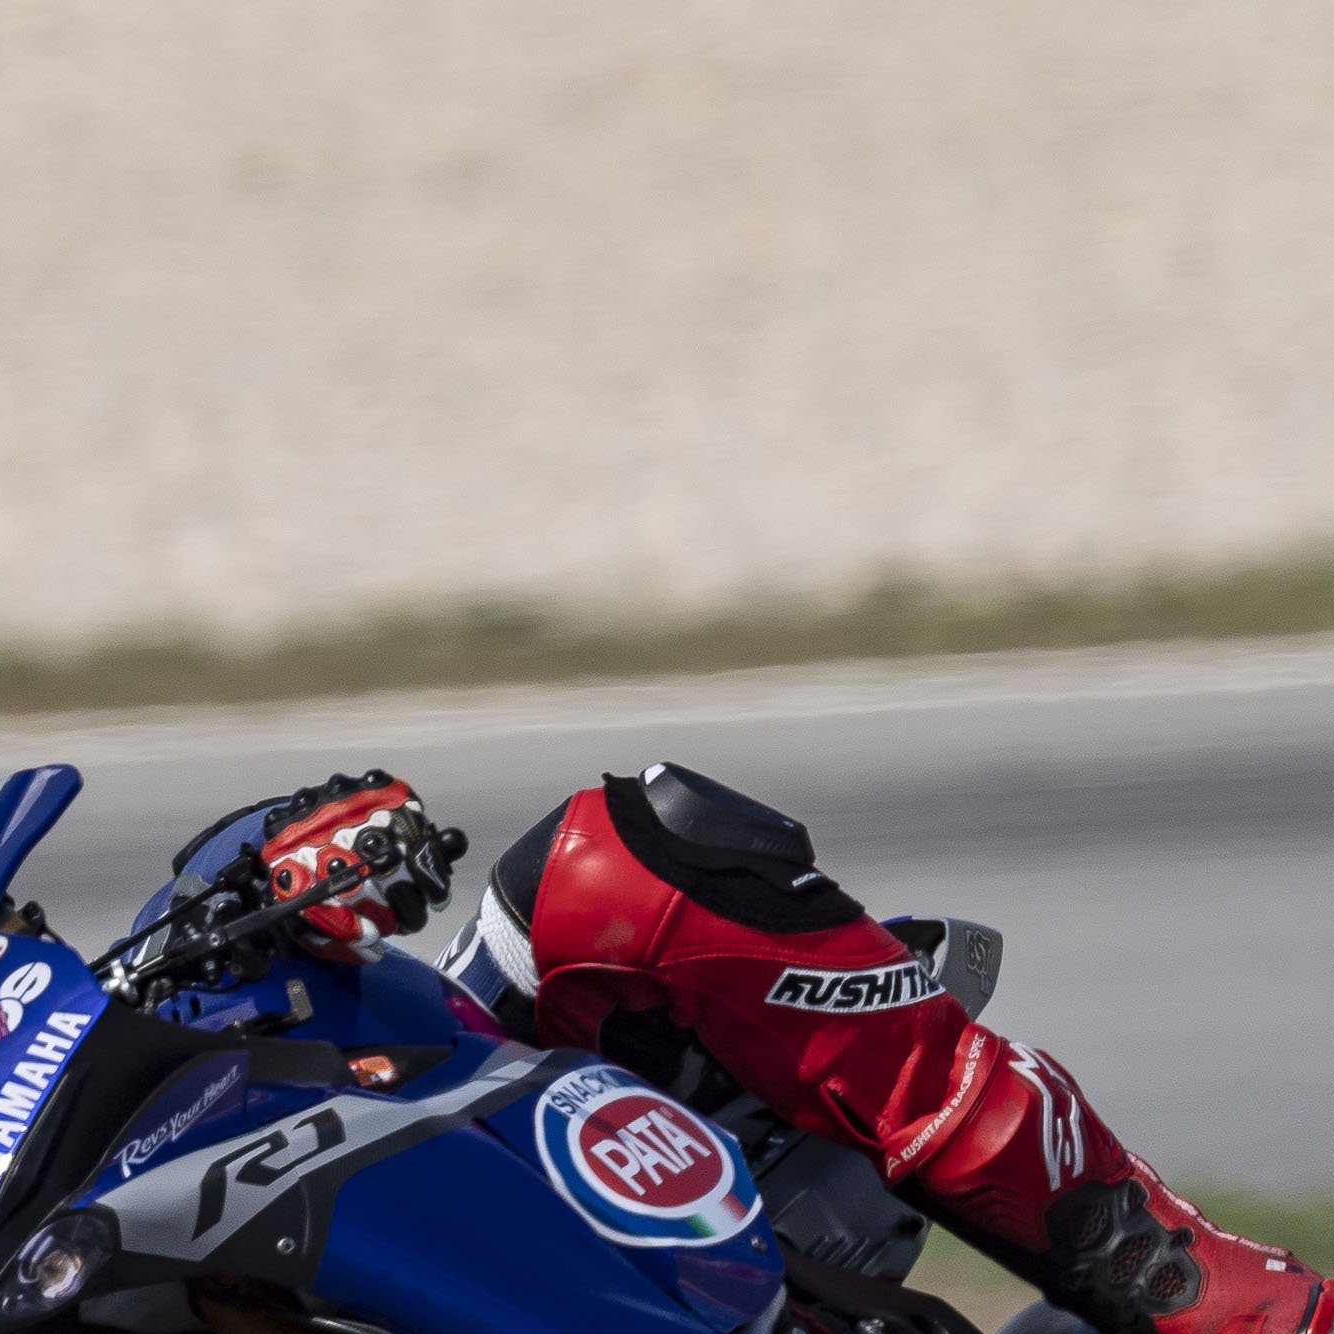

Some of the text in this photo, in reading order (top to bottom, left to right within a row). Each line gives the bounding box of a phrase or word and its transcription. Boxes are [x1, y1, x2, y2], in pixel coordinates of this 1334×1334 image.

[113, 1124, 167, 1179] Revs
[169, 1101, 204, 1142] Your
[900, 1033, 987, 1162] KUSHITANI RACING SPEC
[589, 1109, 712, 1197] PATA
